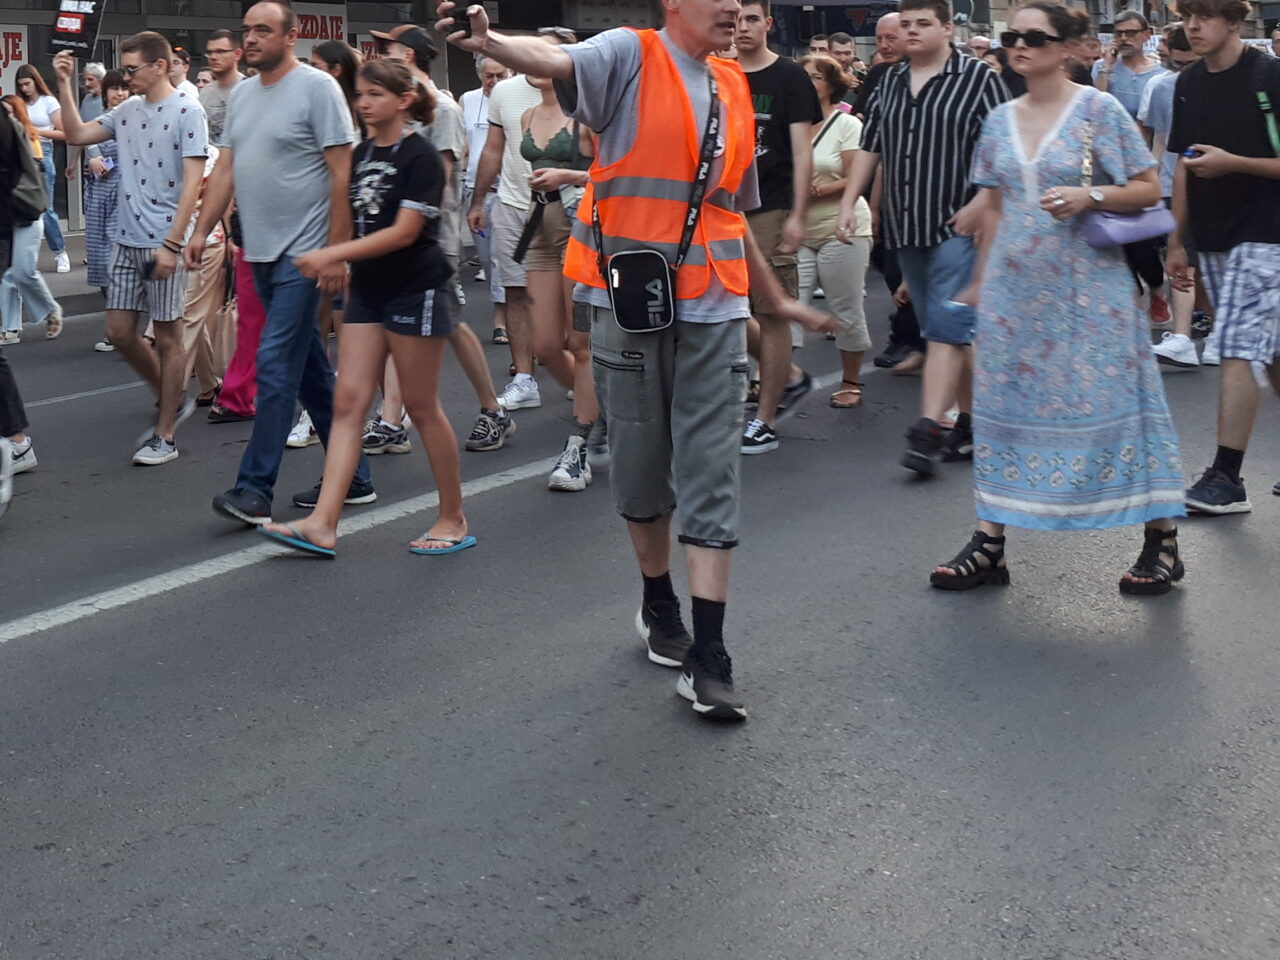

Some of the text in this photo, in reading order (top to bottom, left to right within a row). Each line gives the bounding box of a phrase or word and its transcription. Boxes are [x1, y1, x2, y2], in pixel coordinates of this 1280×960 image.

[698, 162, 710, 180] FILA
[687, 207, 698, 226] FILA
[644, 278, 666, 328] FILA
